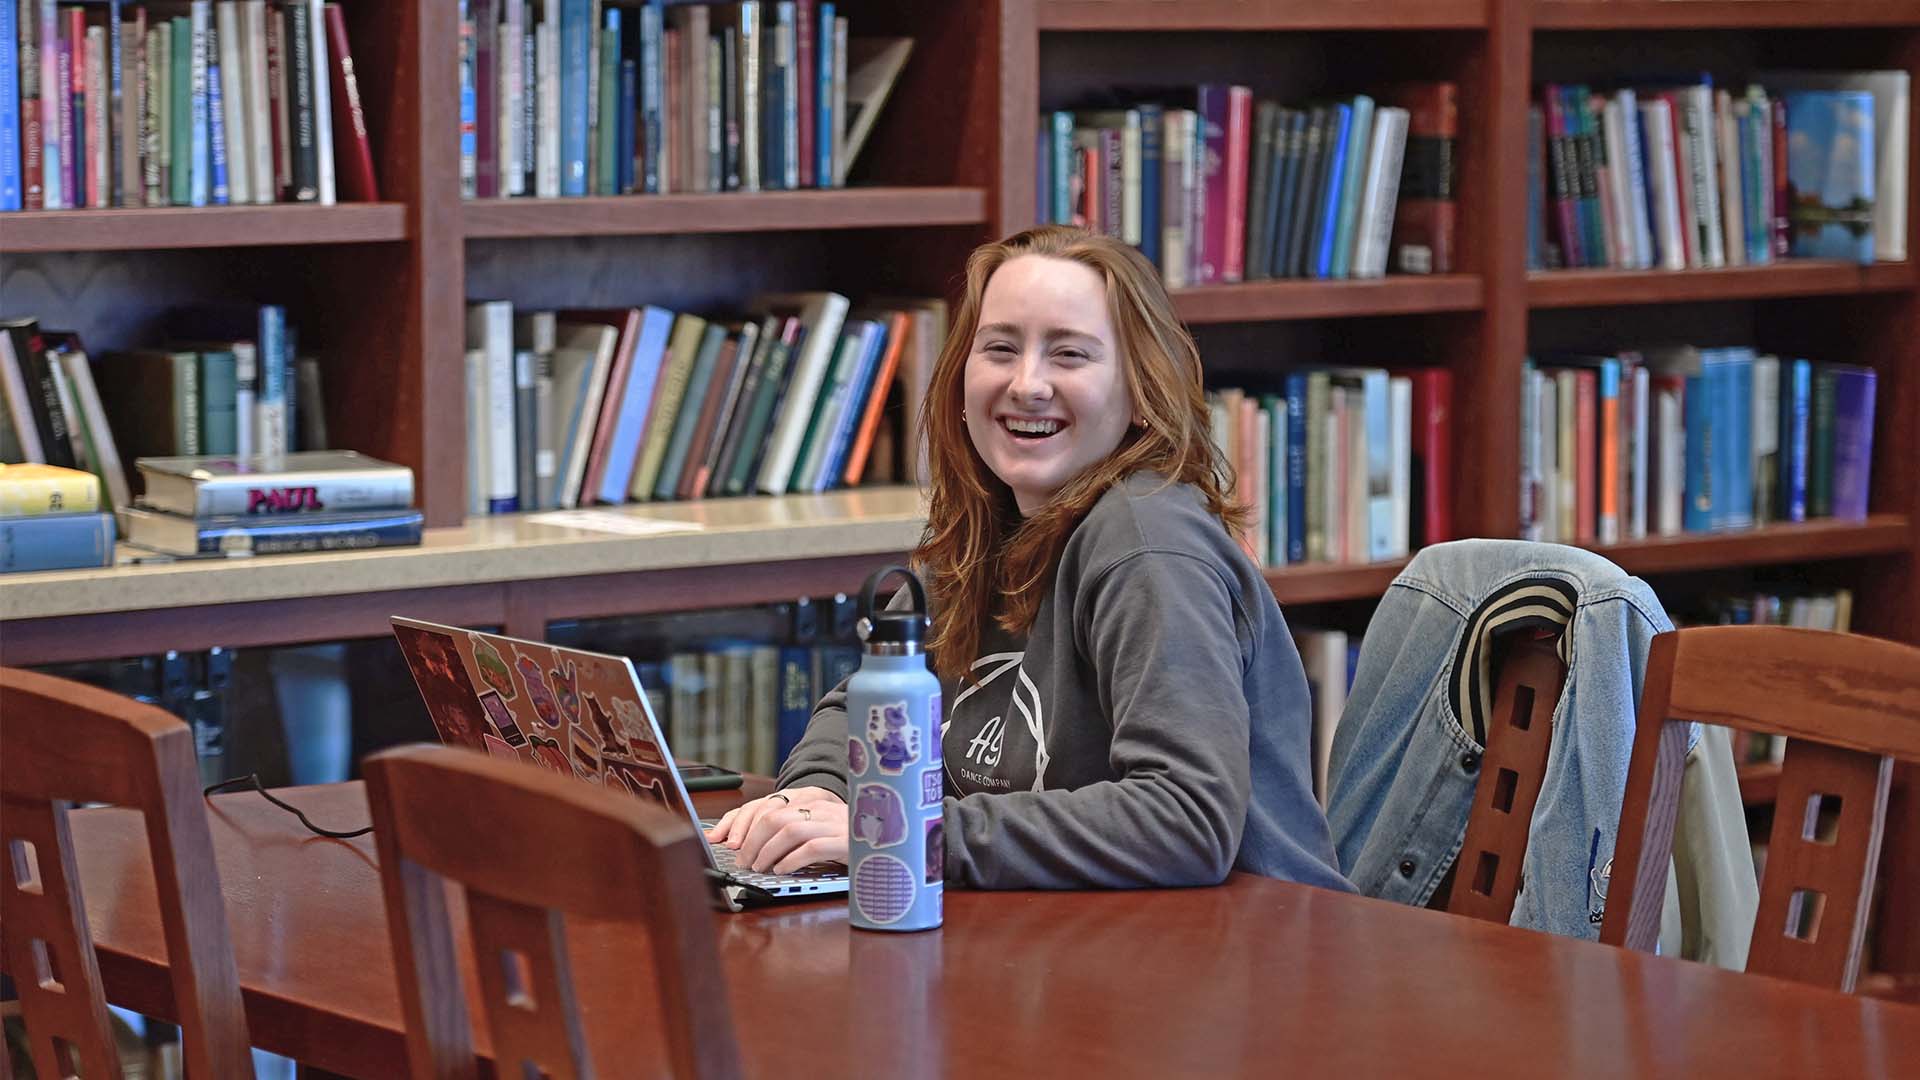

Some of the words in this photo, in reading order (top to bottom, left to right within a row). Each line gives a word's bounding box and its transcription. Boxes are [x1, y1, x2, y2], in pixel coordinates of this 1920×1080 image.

[247, 485, 323, 513] PAUL
[961, 768, 982, 784] DANCE
[982, 775, 1011, 789] COMPANY
